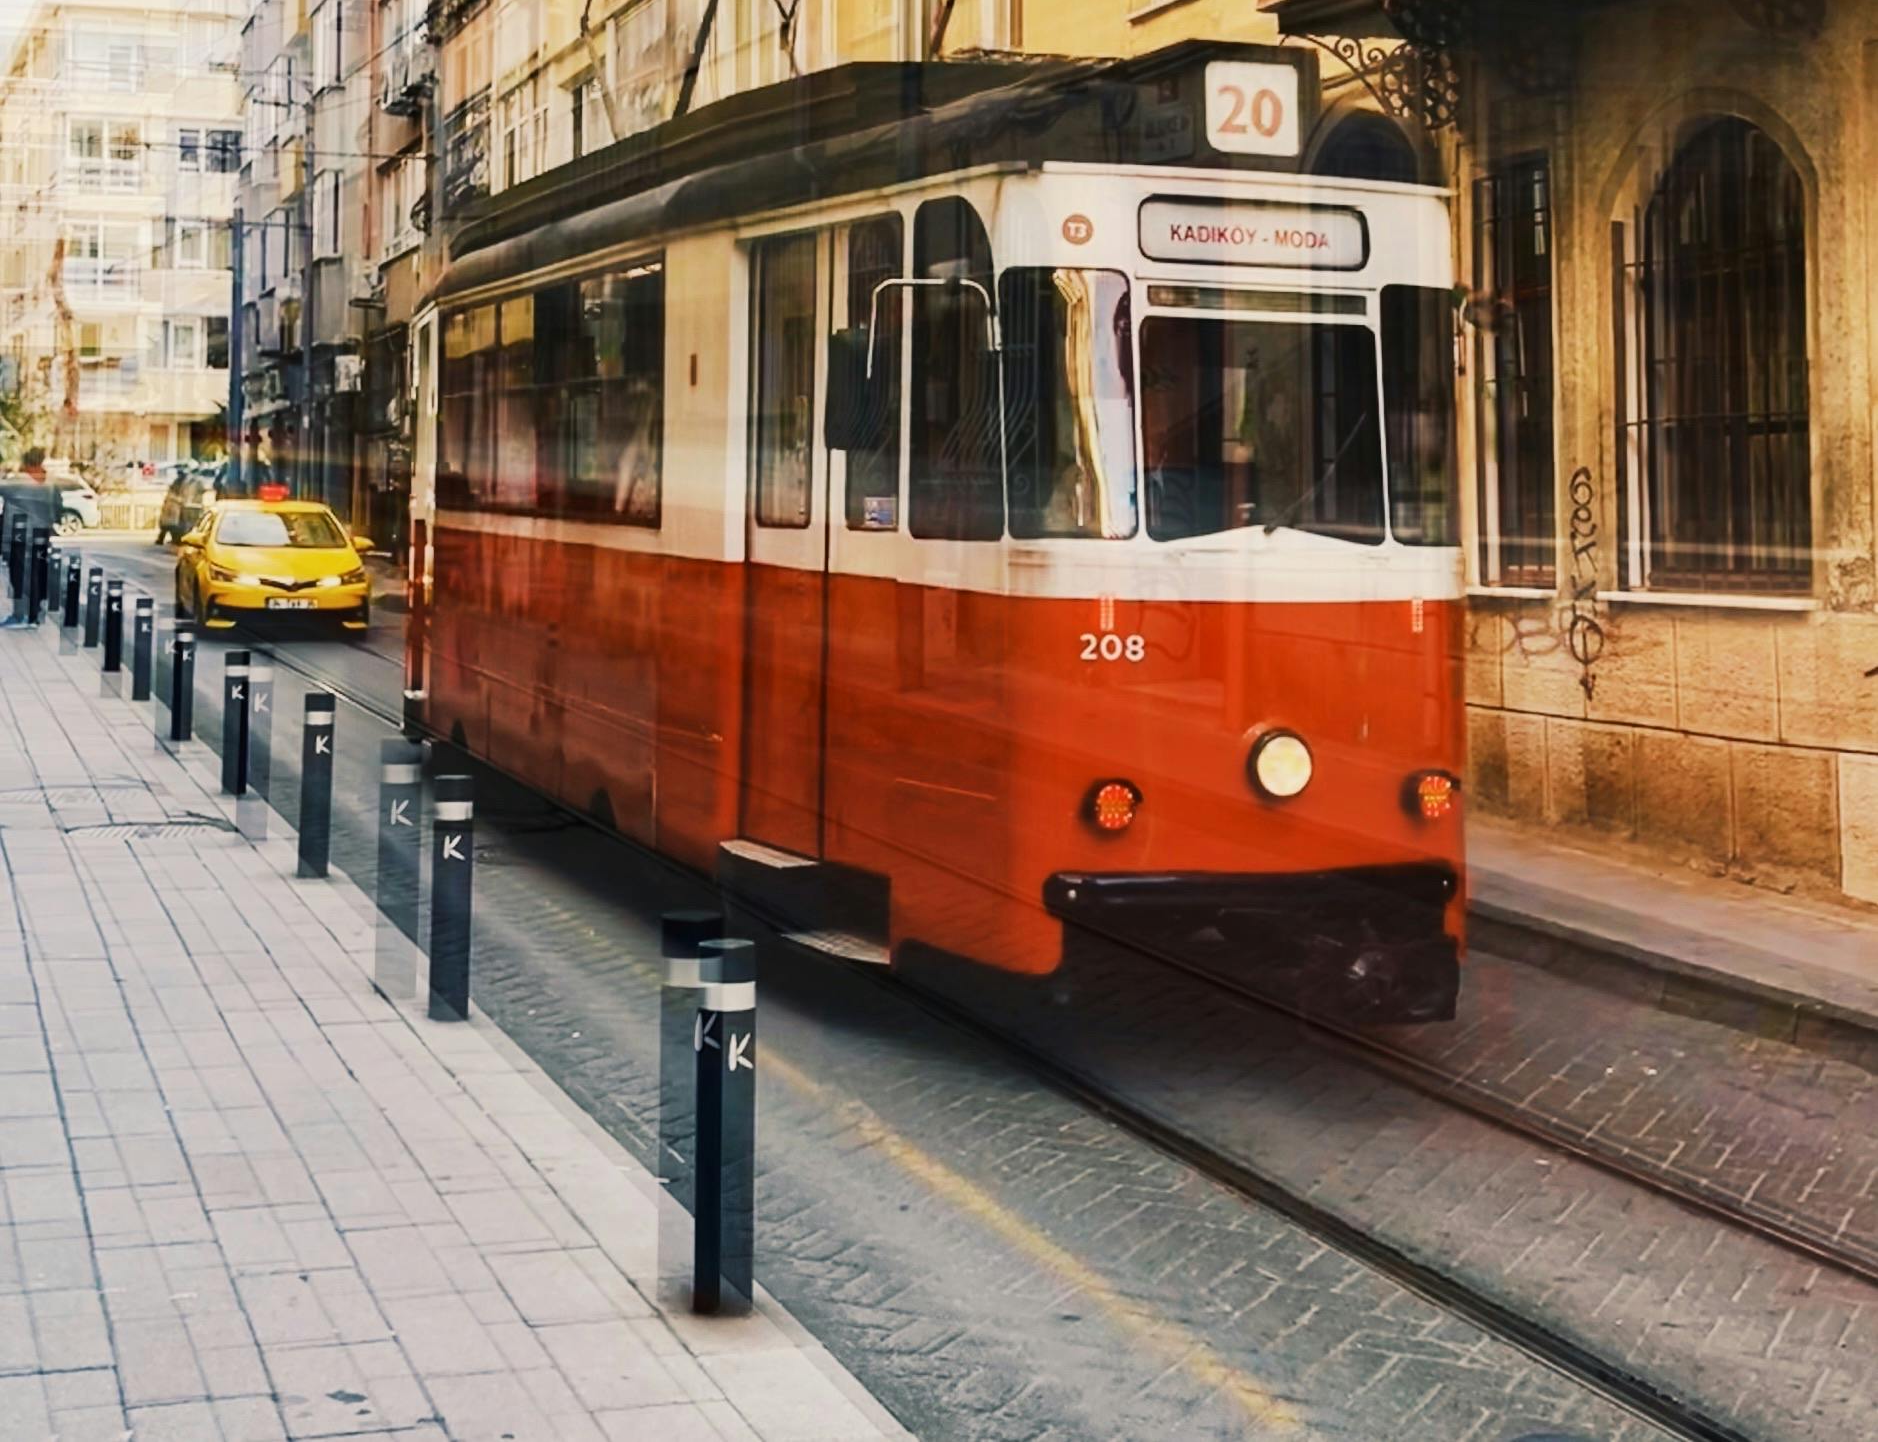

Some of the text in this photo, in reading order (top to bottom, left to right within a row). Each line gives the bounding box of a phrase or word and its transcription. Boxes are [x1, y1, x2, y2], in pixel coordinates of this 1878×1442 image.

[1216, 84, 1283, 138] 20
[1274, 229, 1330, 250] MODA
[1079, 633, 1146, 661] 208
[231, 684, 245, 700] K
[315, 734, 331, 755] K
[390, 798, 414, 827] K
[443, 834, 465, 861] K
[728, 1032, 754, 1072] K
